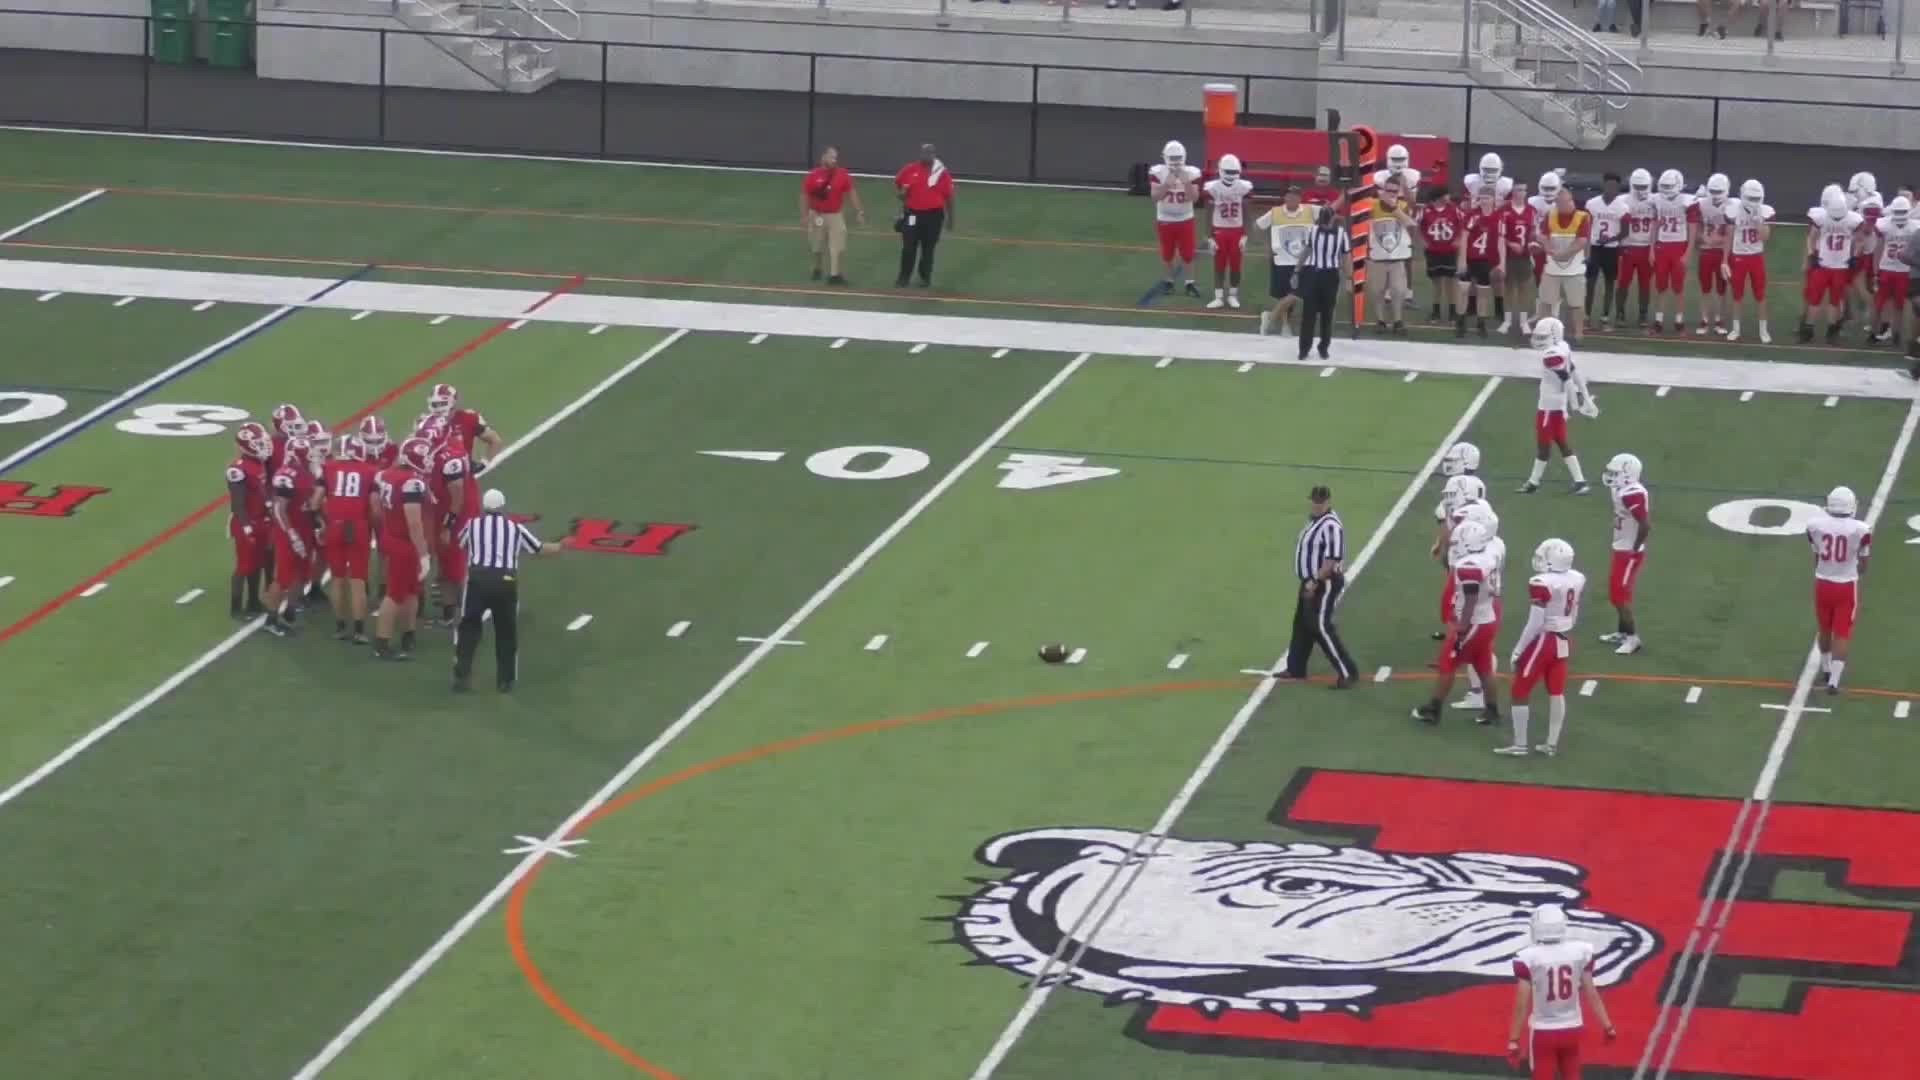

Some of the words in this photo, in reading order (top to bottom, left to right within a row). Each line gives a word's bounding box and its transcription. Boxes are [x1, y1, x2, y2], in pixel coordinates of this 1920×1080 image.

[1336, 136, 1352, 168] 1
[1472, 231, 1488, 255] 4
[333, 470, 360, 498] 18
[1821, 533, 1848, 563] 30
[1565, 588, 1576, 617] 8
[1547, 964, 1573, 1002] 16
